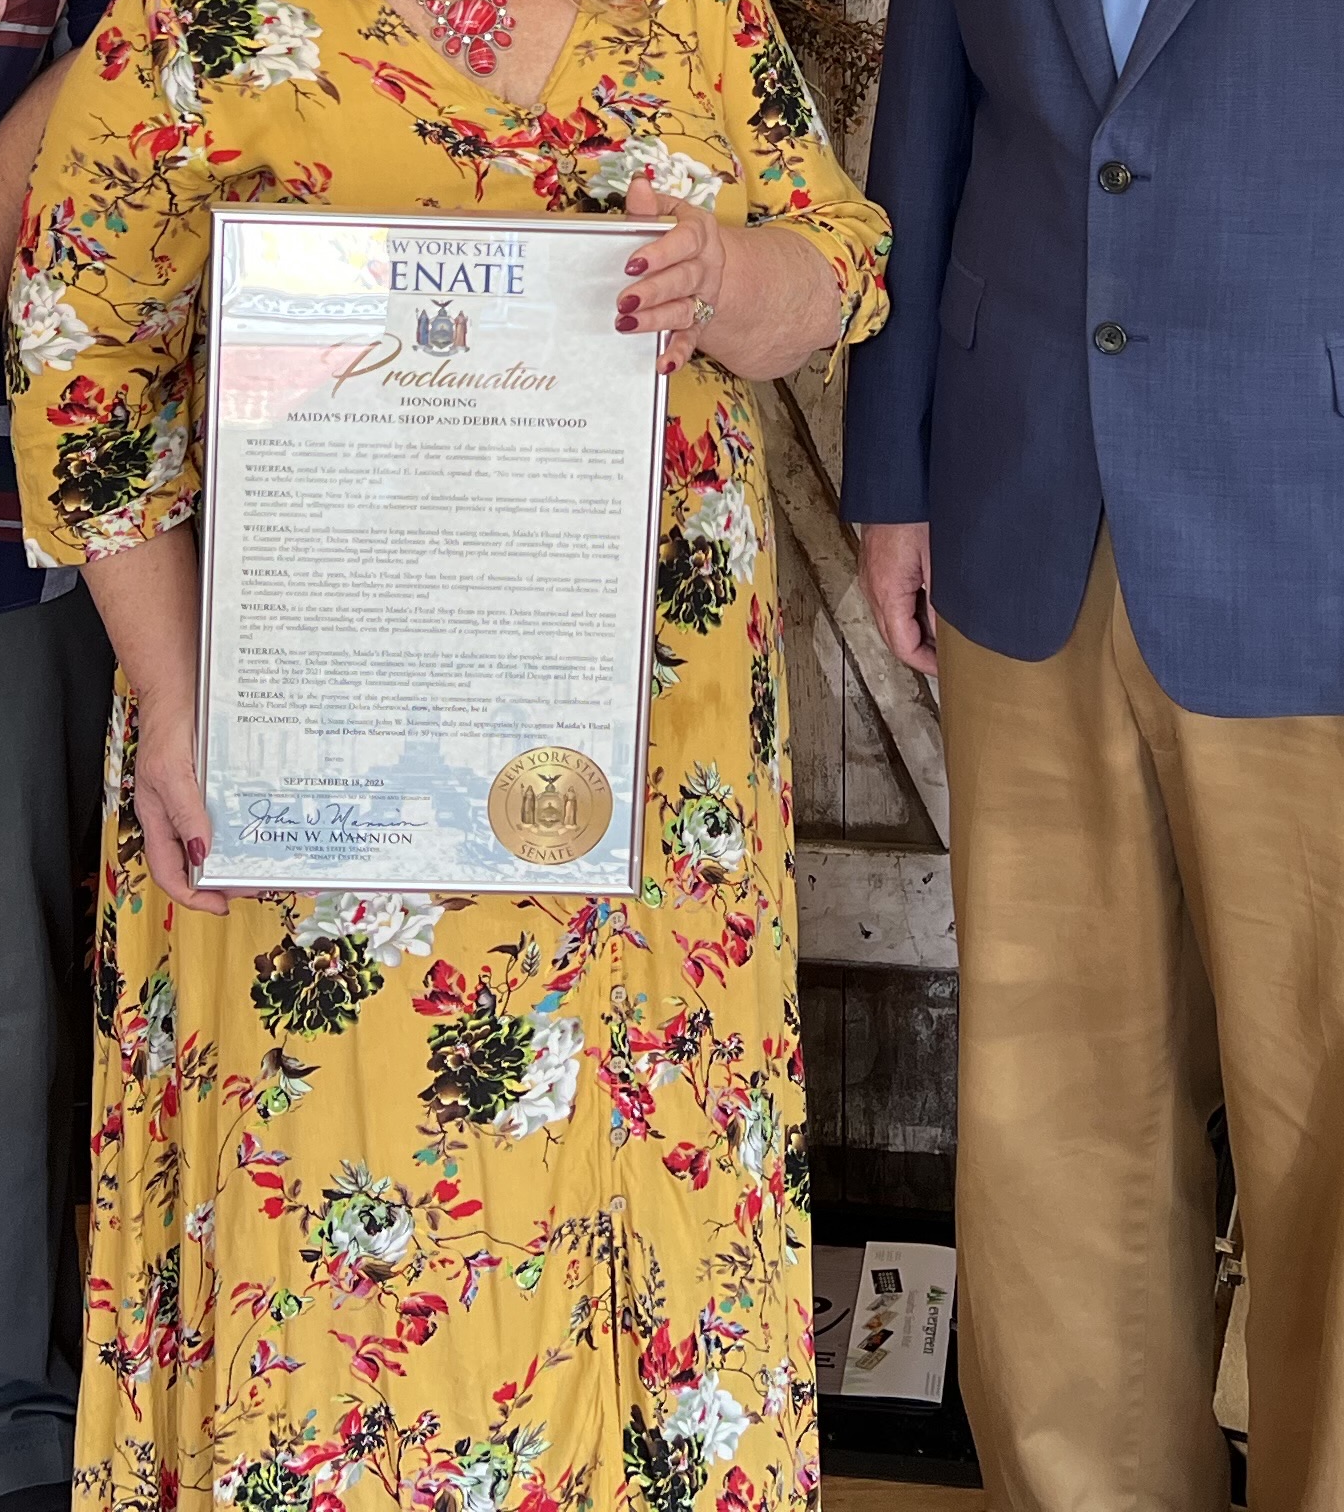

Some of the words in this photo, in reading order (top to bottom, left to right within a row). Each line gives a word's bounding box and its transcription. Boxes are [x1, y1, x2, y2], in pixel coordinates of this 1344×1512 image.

[415, 240, 468, 257] YORK
[473, 242, 527, 259] STATE
[322, 332, 559, 399] Proclamation
[400, 396, 477, 409] HONORING
[287, 411, 342, 424] MAIDA'S
[344, 412, 396, 424] FLORAL
[398, 413, 434, 425] SHOP
[436, 415, 460, 426] AND
[462, 414, 507, 426] DEBRA
[509, 415, 587, 428] SHERWOOD
[497, 760, 525, 792] NEW
[527, 751, 571, 766] YORK
[574, 758, 606, 793] STATE
[283, 776, 349, 787] SEPTEMBER
[254, 829, 298, 844] JOHN
[304, 830, 324, 843] W.
[329, 831, 413, 845] MANNION
[520, 844, 574, 861] SENATE
